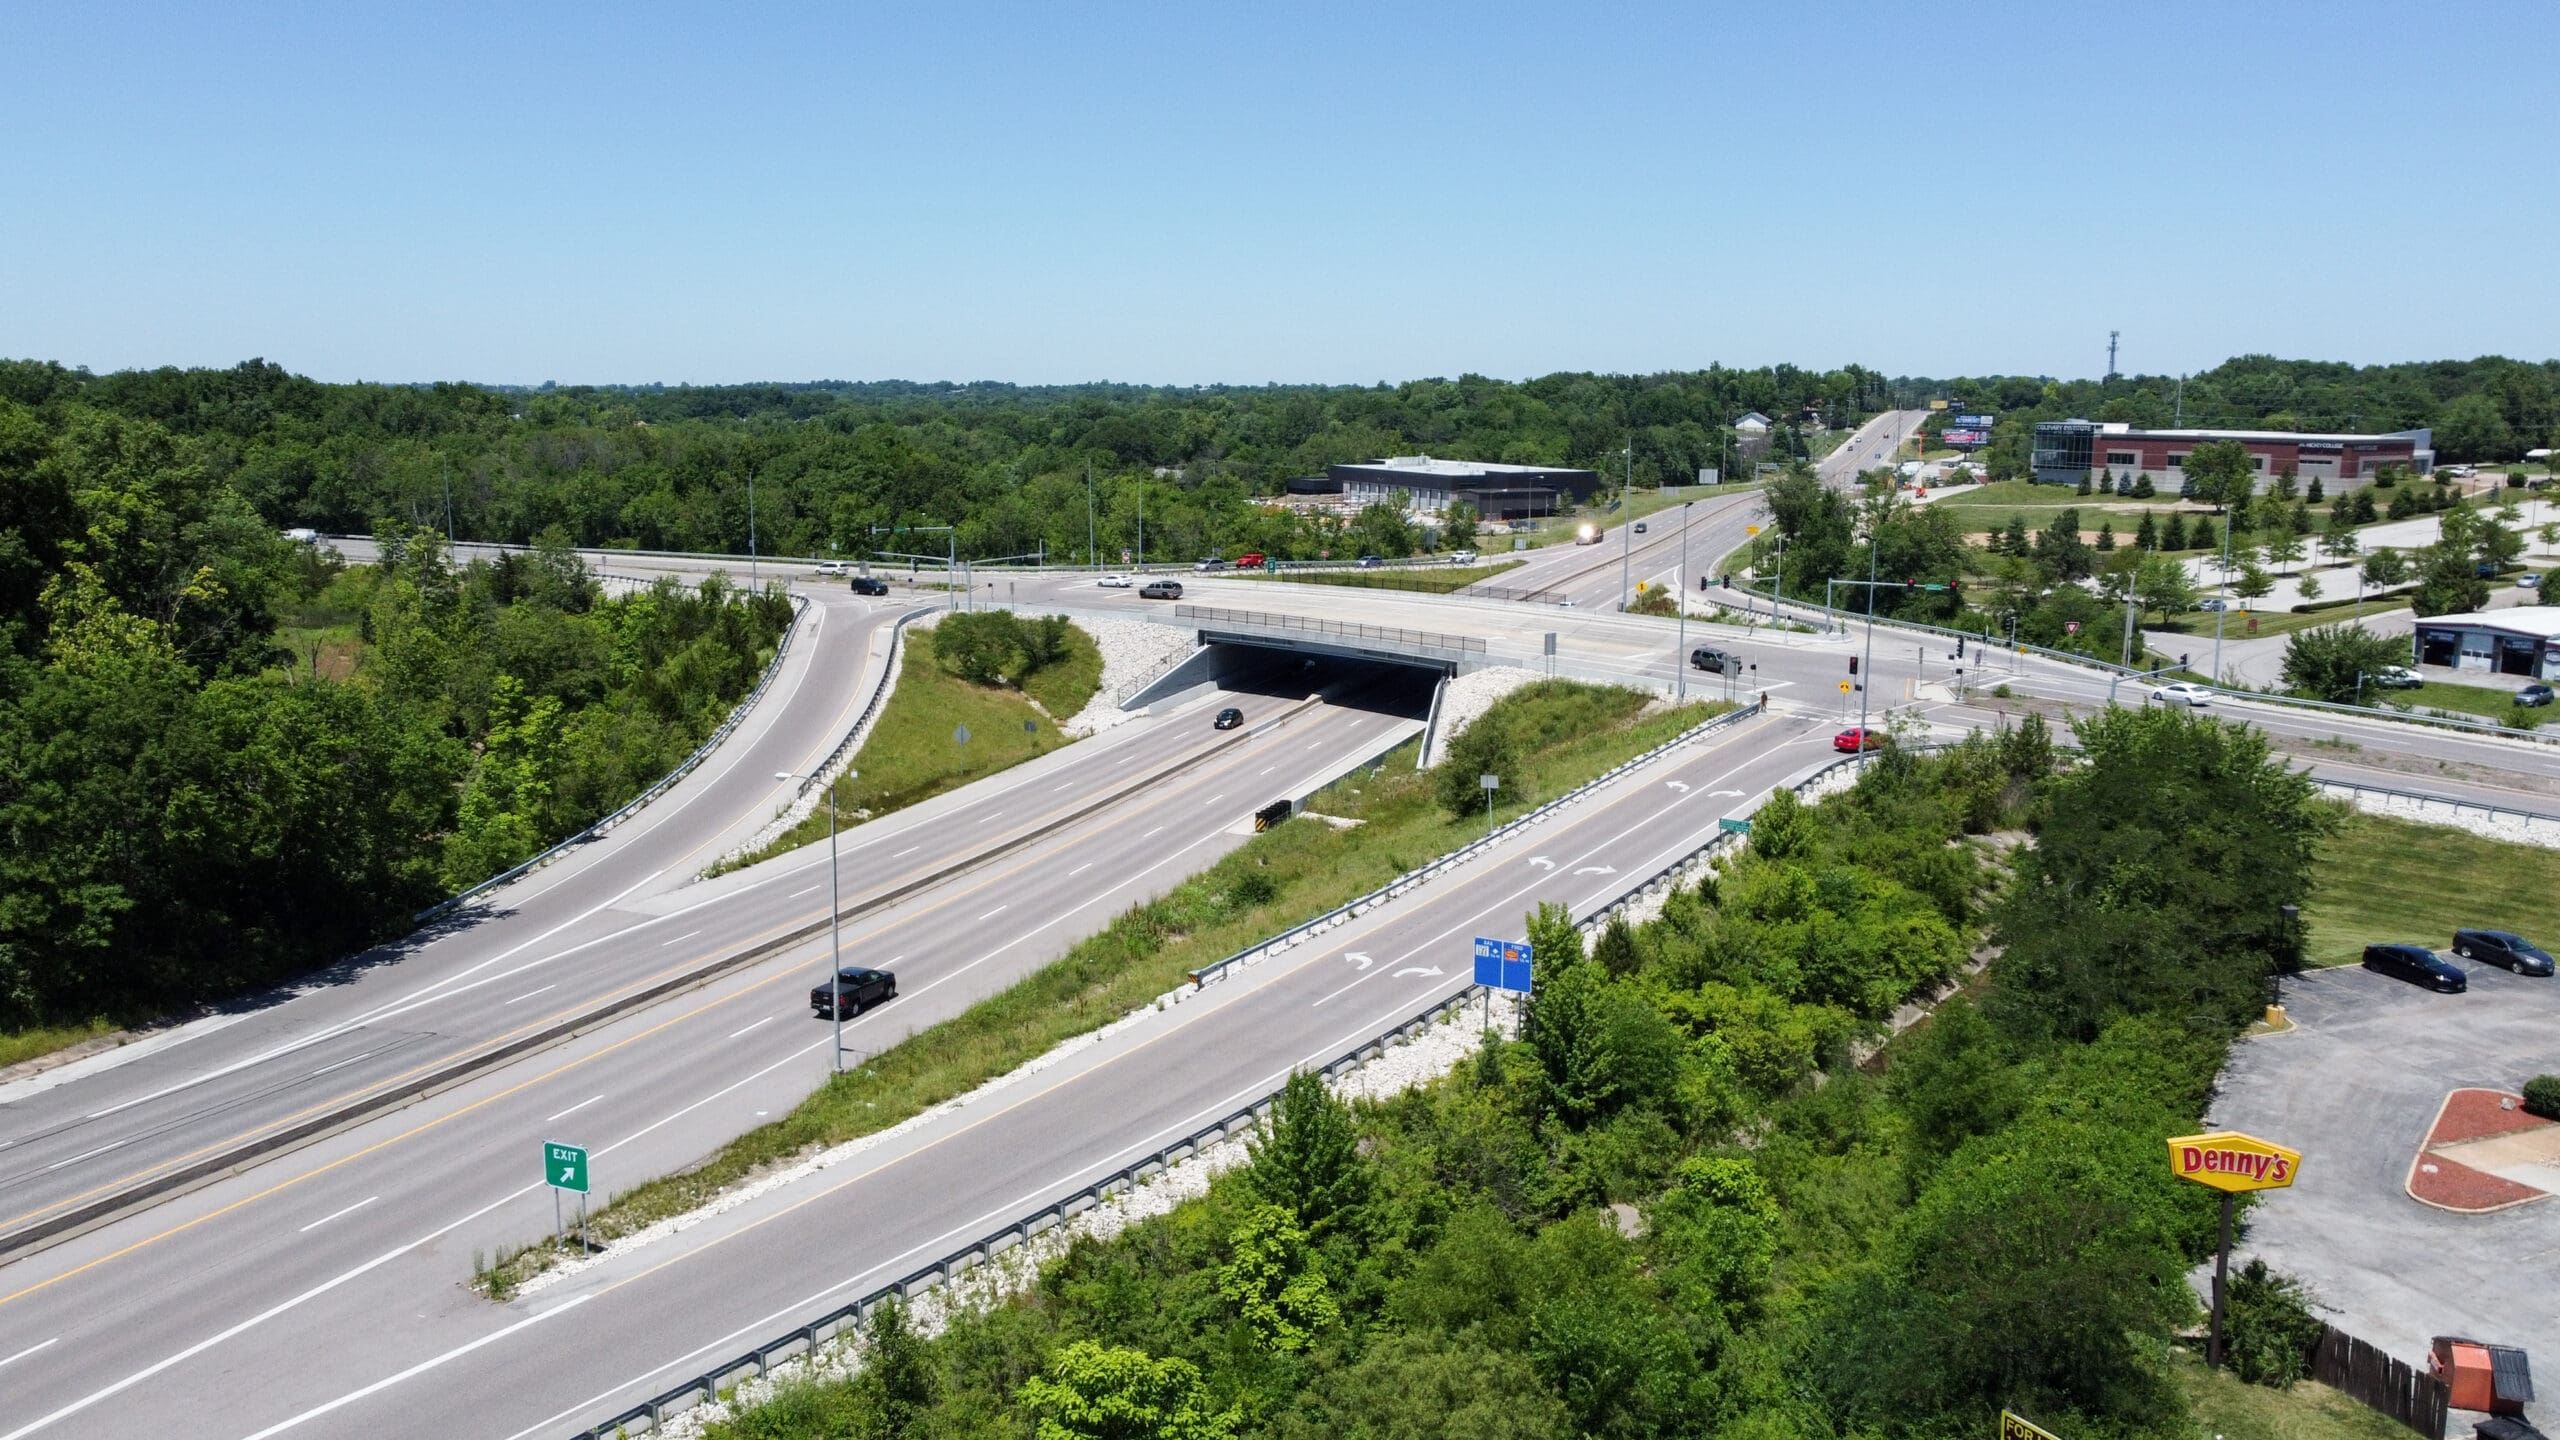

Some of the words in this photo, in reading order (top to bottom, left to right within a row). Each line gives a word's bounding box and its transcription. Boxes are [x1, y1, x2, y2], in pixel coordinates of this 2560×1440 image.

[552, 1148, 578, 1162] EXIT
[2182, 1146, 2290, 1181] Denny's
[2006, 1419, 2034, 1440] FOR
